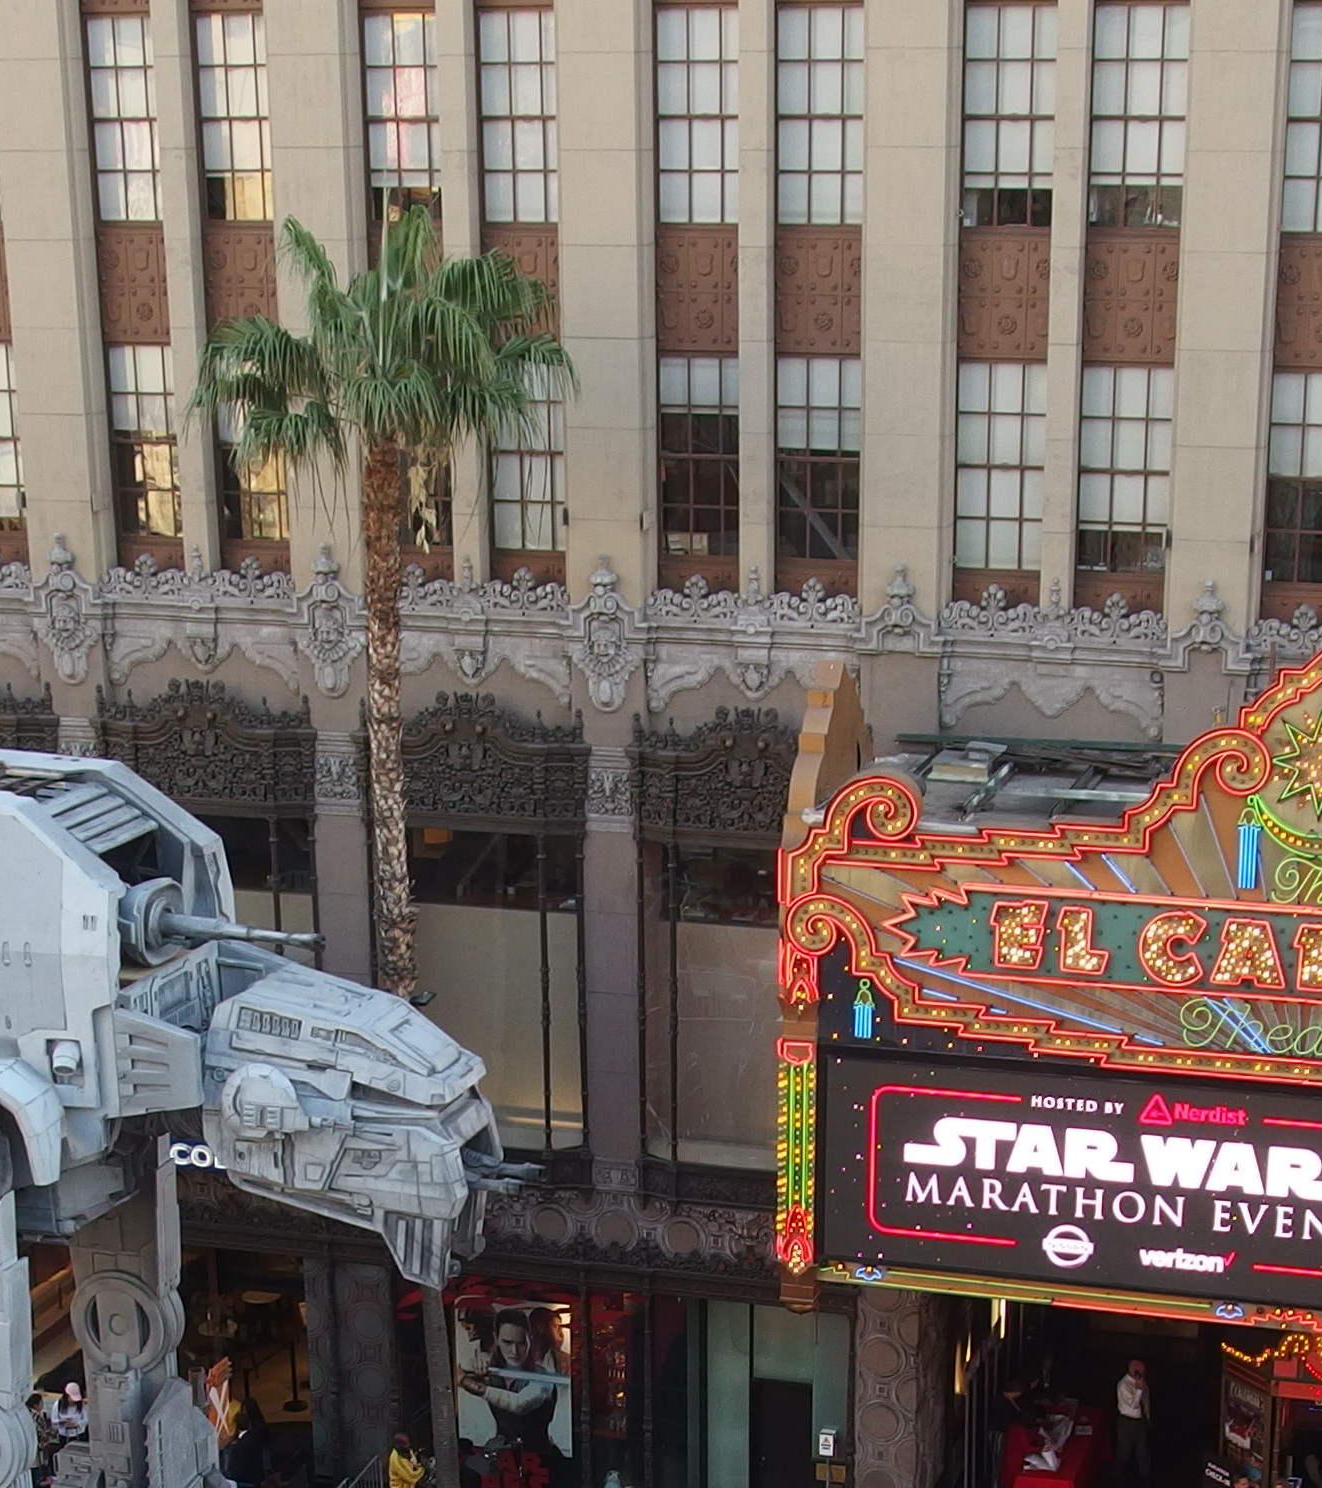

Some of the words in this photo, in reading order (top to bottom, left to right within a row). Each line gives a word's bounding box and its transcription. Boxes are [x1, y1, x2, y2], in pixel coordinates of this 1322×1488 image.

[989, 899, 1109, 975] EL
[1030, 1095, 1098, 1113] HOSTED
[1104, 1101, 1125, 1115] BY
[1173, 1102, 1247, 1126] Nerdist
[903, 1116, 1135, 1183] STAR
[904, 1171, 1186, 1228] MARATHON
[1139, 1248, 1225, 1273] verizon
